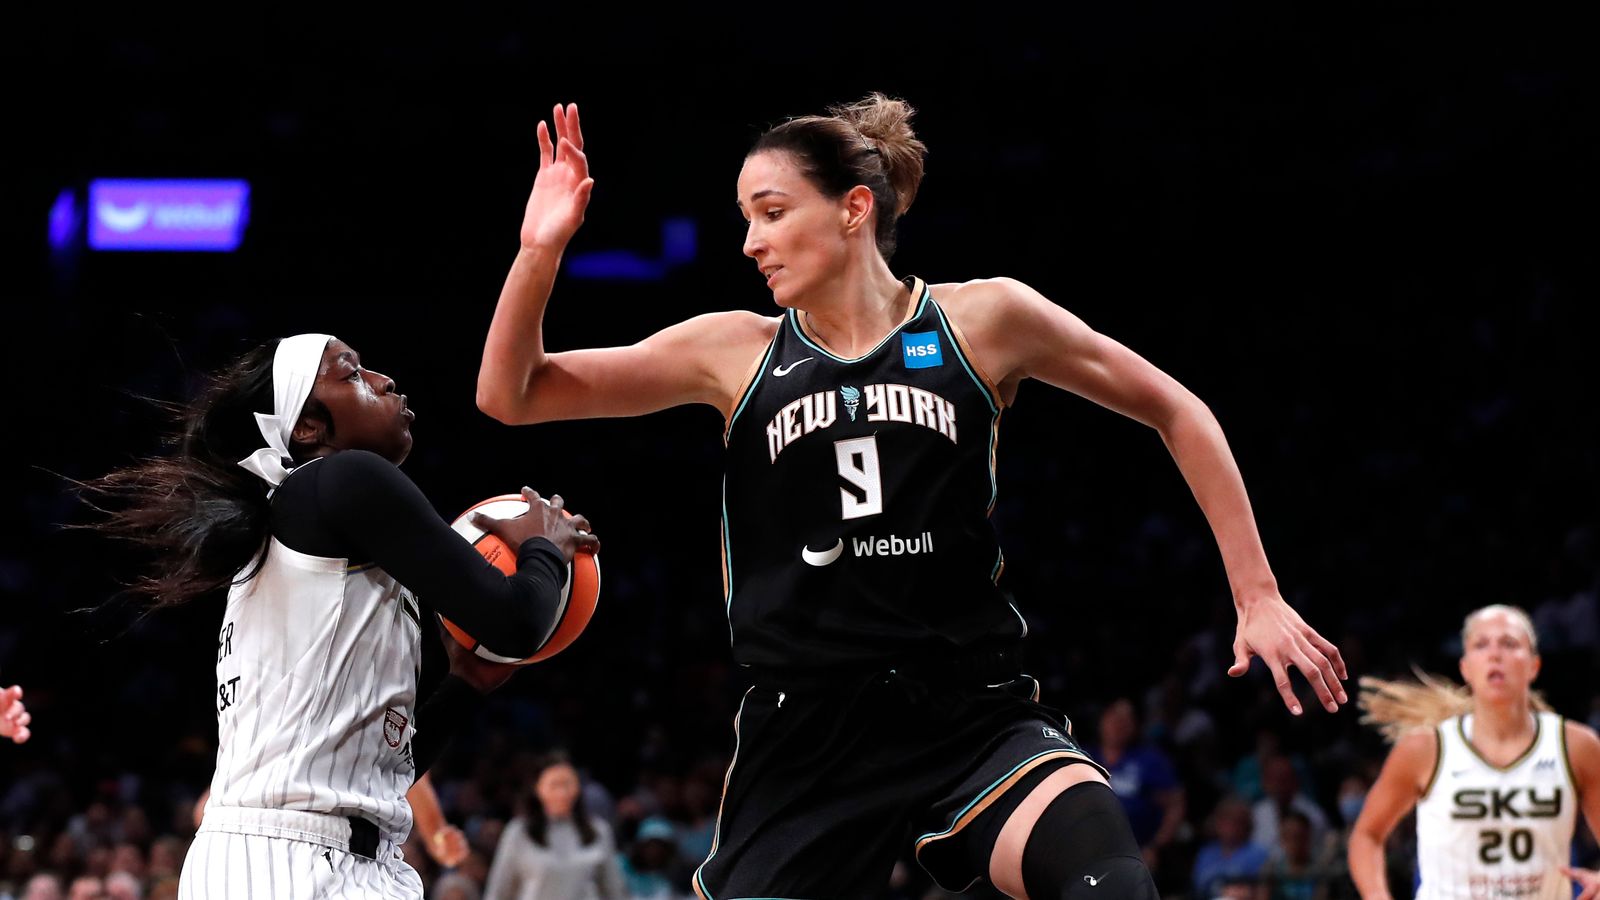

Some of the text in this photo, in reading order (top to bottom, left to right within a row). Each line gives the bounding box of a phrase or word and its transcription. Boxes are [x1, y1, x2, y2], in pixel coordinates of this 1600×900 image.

[906, 344, 937, 357] HSS
[766, 384, 957, 464] NEW YORK
[833, 435, 883, 520] 9
[852, 532, 934, 557] Webull
[218, 675, 241, 712] &T
[1451, 787, 1562, 820] SKY
[1478, 828, 1534, 864] 20
